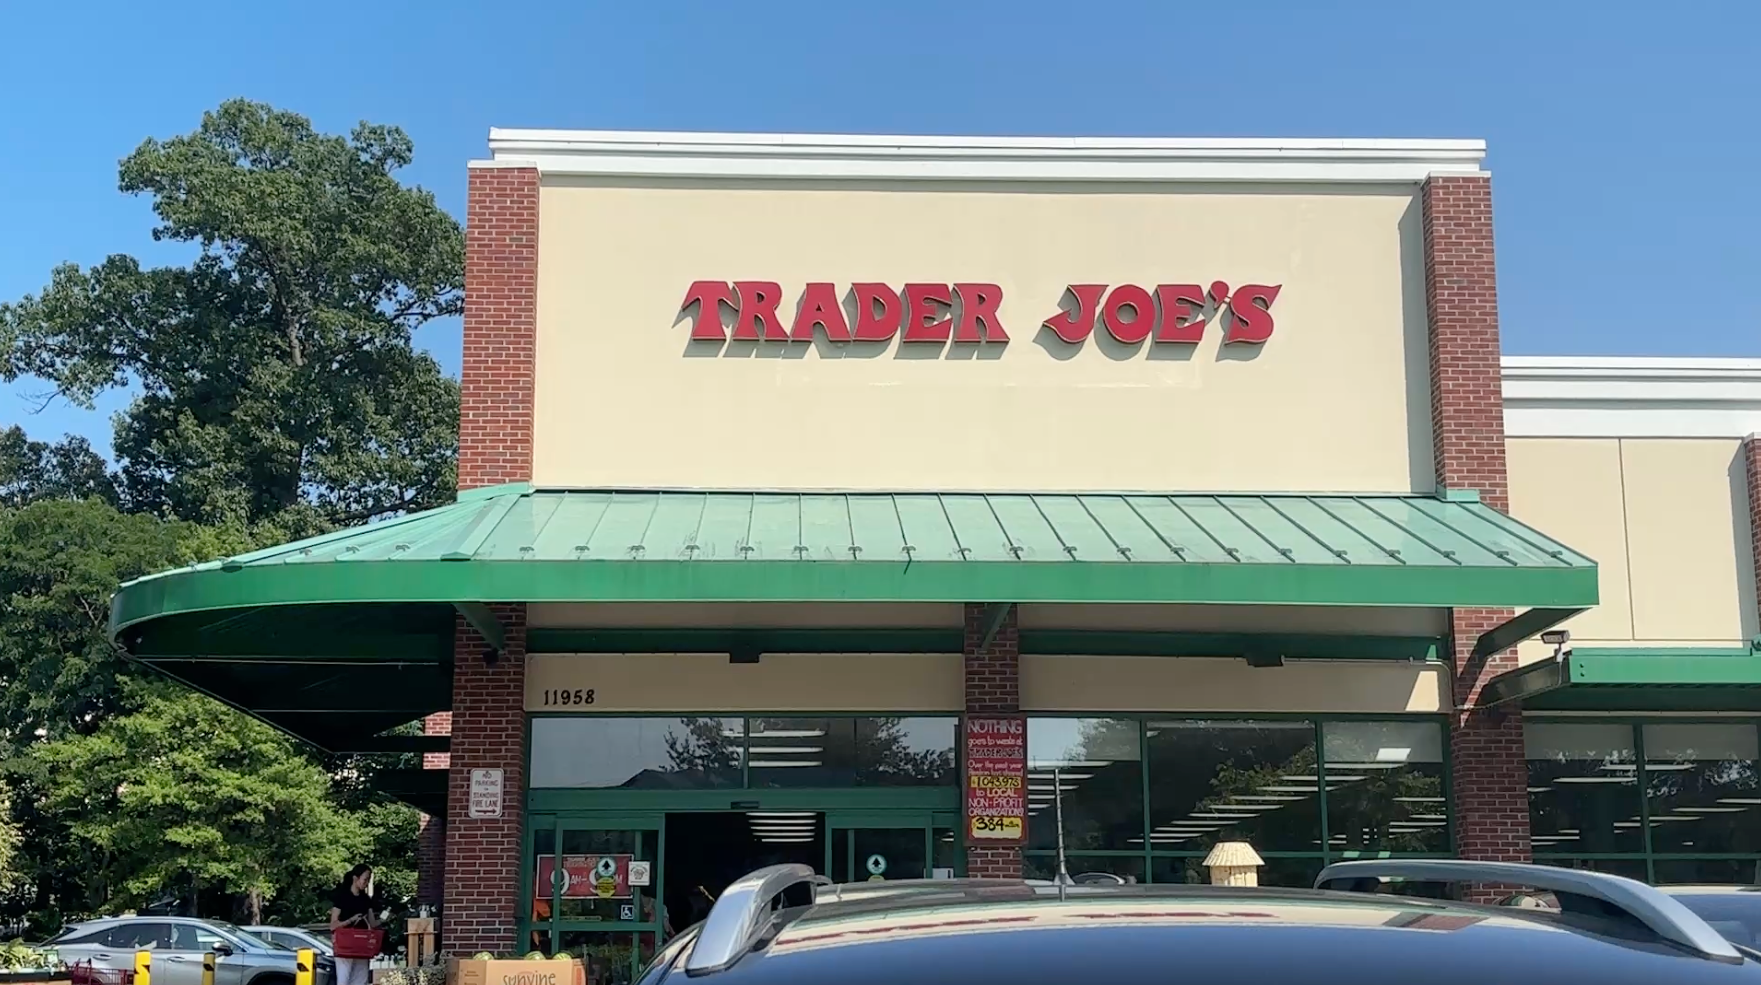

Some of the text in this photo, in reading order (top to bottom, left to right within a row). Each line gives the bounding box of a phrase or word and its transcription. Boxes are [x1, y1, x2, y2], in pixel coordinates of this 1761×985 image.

[682, 280, 1283, 346] TRADER JOE'S
[544, 689, 595, 706] 11958
[967, 719, 1023, 734] NOTHING
[975, 788, 1018, 798] to LOCAL
[485, 799, 499, 808] LANE
